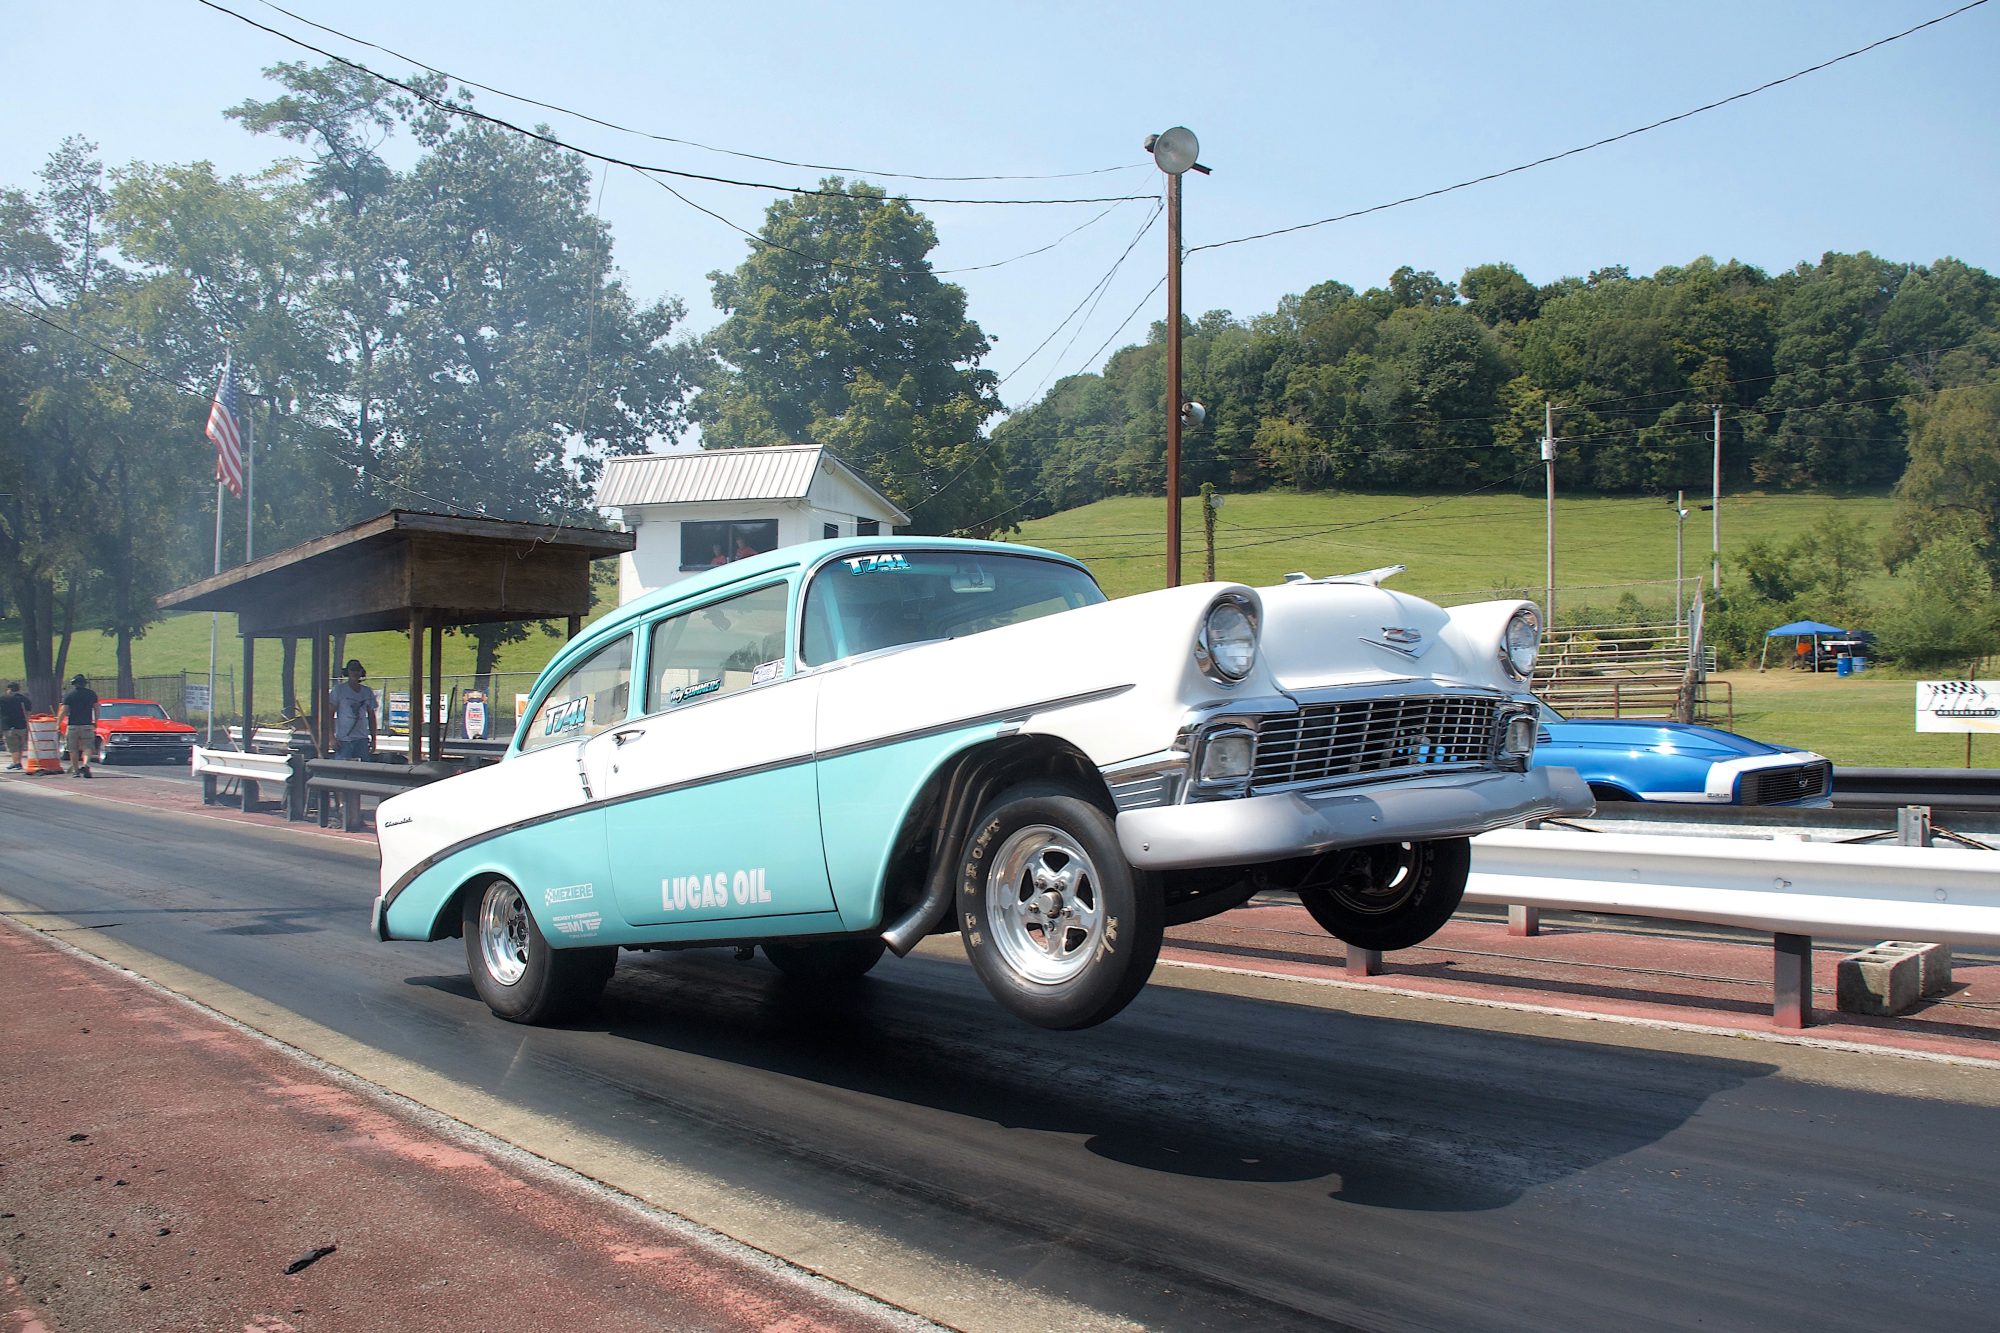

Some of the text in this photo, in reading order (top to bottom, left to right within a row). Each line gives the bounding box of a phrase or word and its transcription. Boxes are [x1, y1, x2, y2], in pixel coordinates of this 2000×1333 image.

[842, 553, 911, 575] T741
[545, 695, 589, 736] T741
[964, 817, 1001, 896] FRONT
[551, 884, 593, 902] MEZIERE
[661, 867, 772, 911] LUCAS OIL
